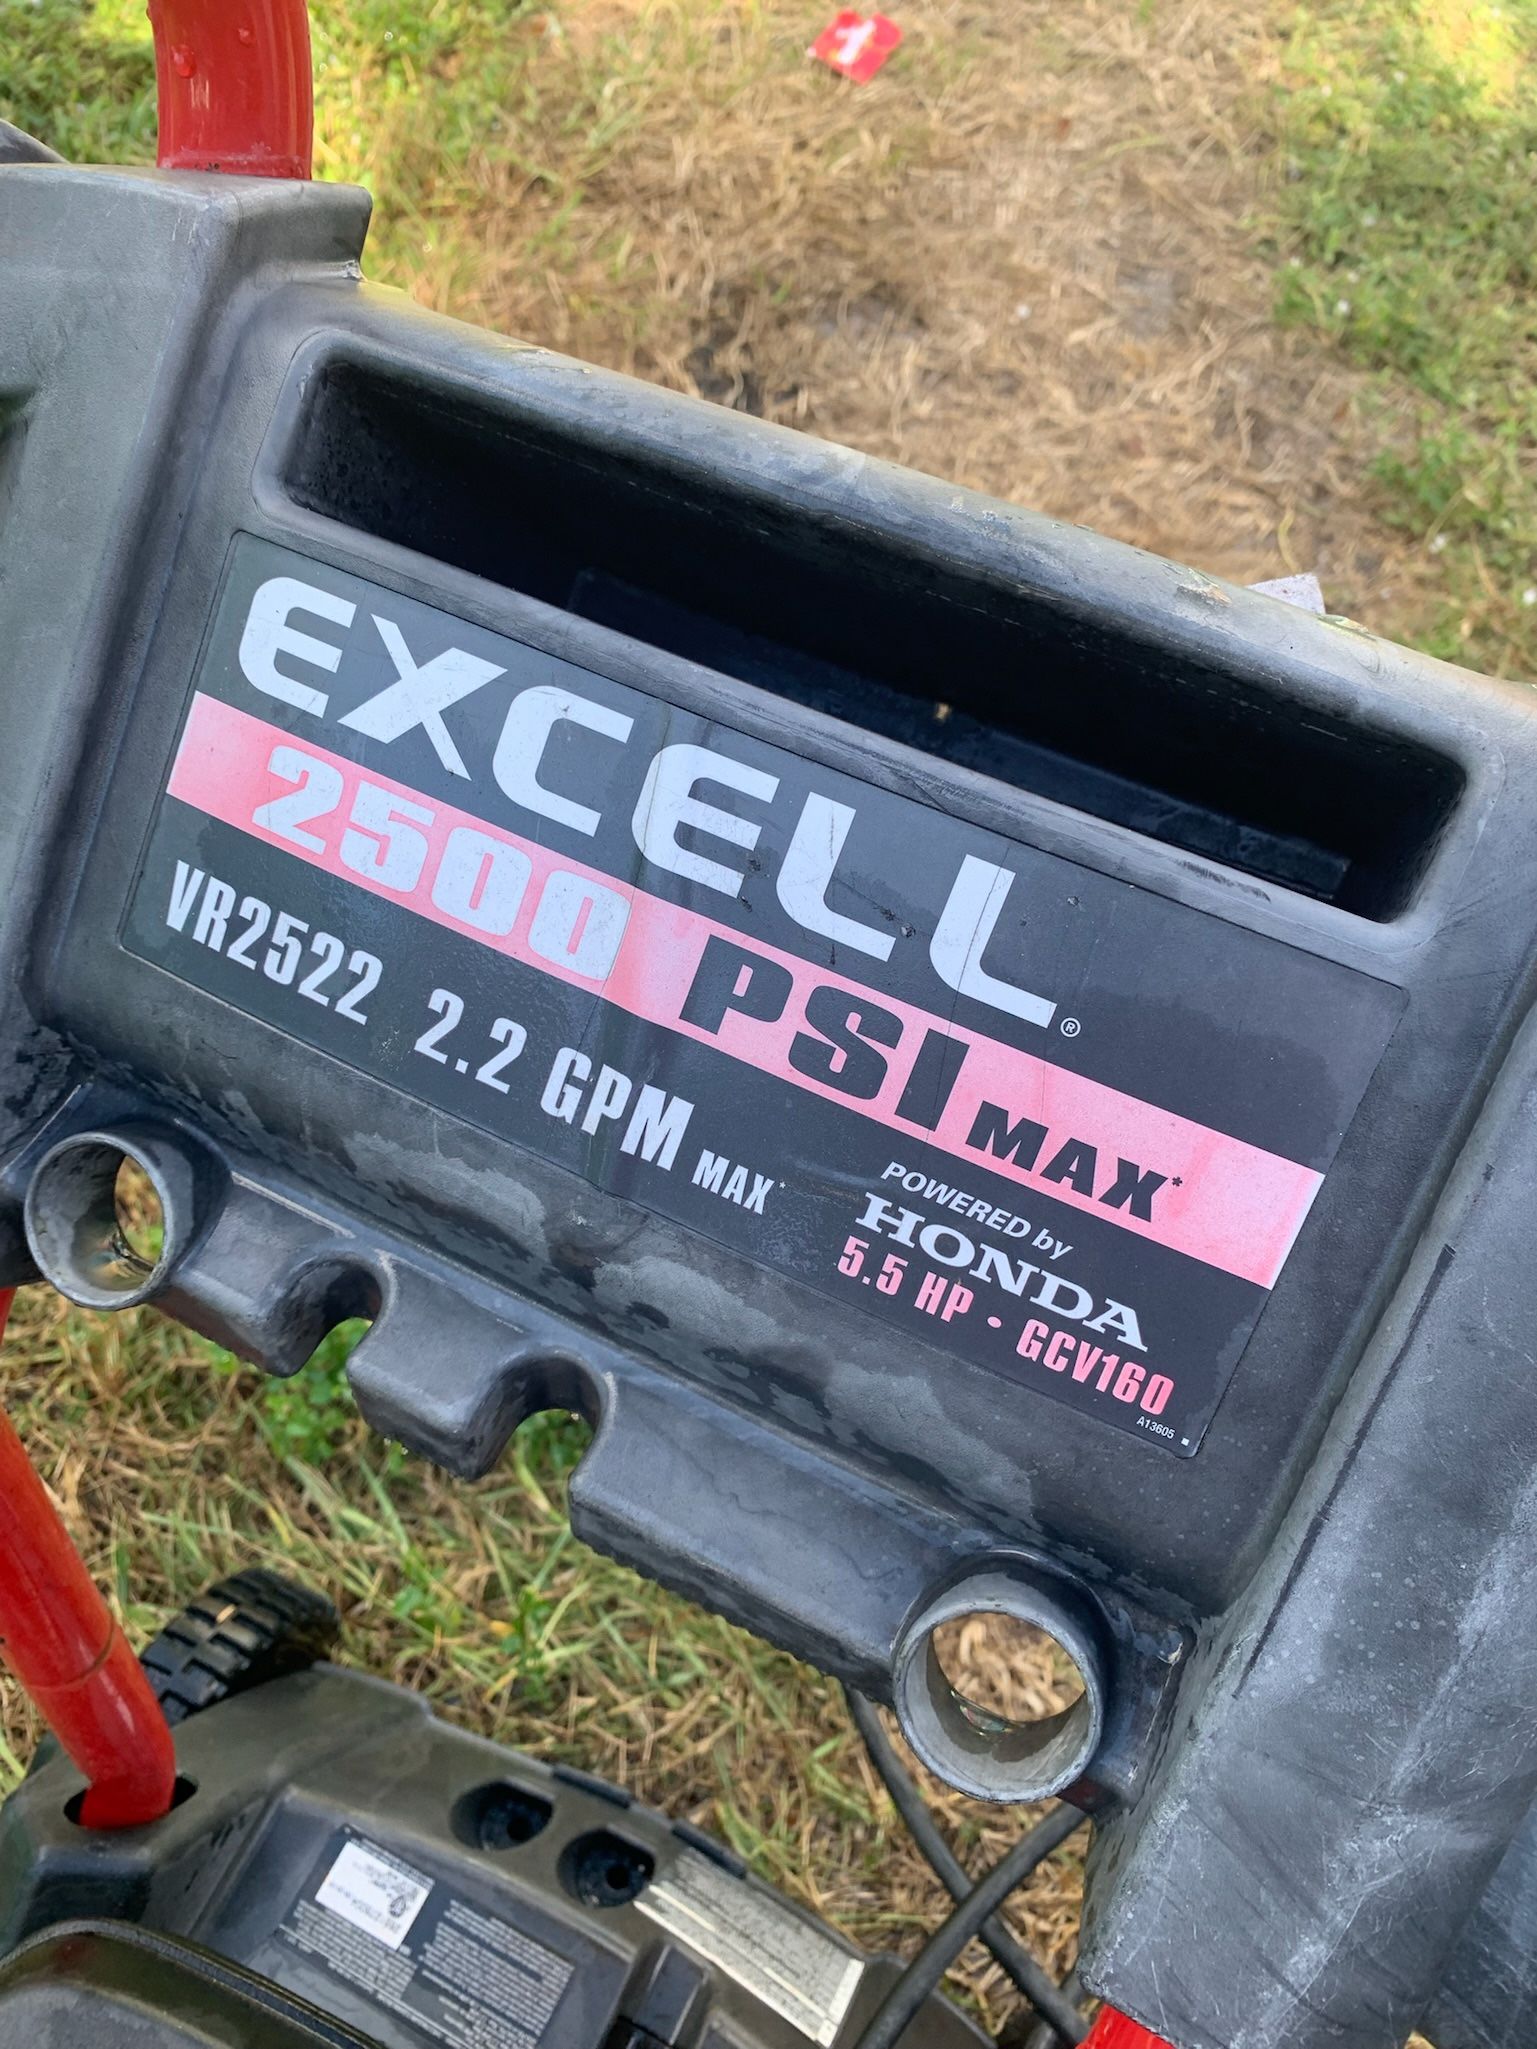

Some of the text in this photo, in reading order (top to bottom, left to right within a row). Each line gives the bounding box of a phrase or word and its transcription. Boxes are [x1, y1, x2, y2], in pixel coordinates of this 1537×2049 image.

[166, 860, 383, 1025] VR2522
[414, 988, 527, 1094] 2.2
[540, 1047, 694, 1171] GPM
[251, 745, 631, 981] 2500
[679, 933, 970, 1132] PSI
[855, 1192, 1148, 1352] HONDA
[881, 1162, 1073, 1260] POWERED by
[837, 1236, 1174, 1415] 5.5 HP GCV160
[1137, 1416, 1175, 1439] A13605
